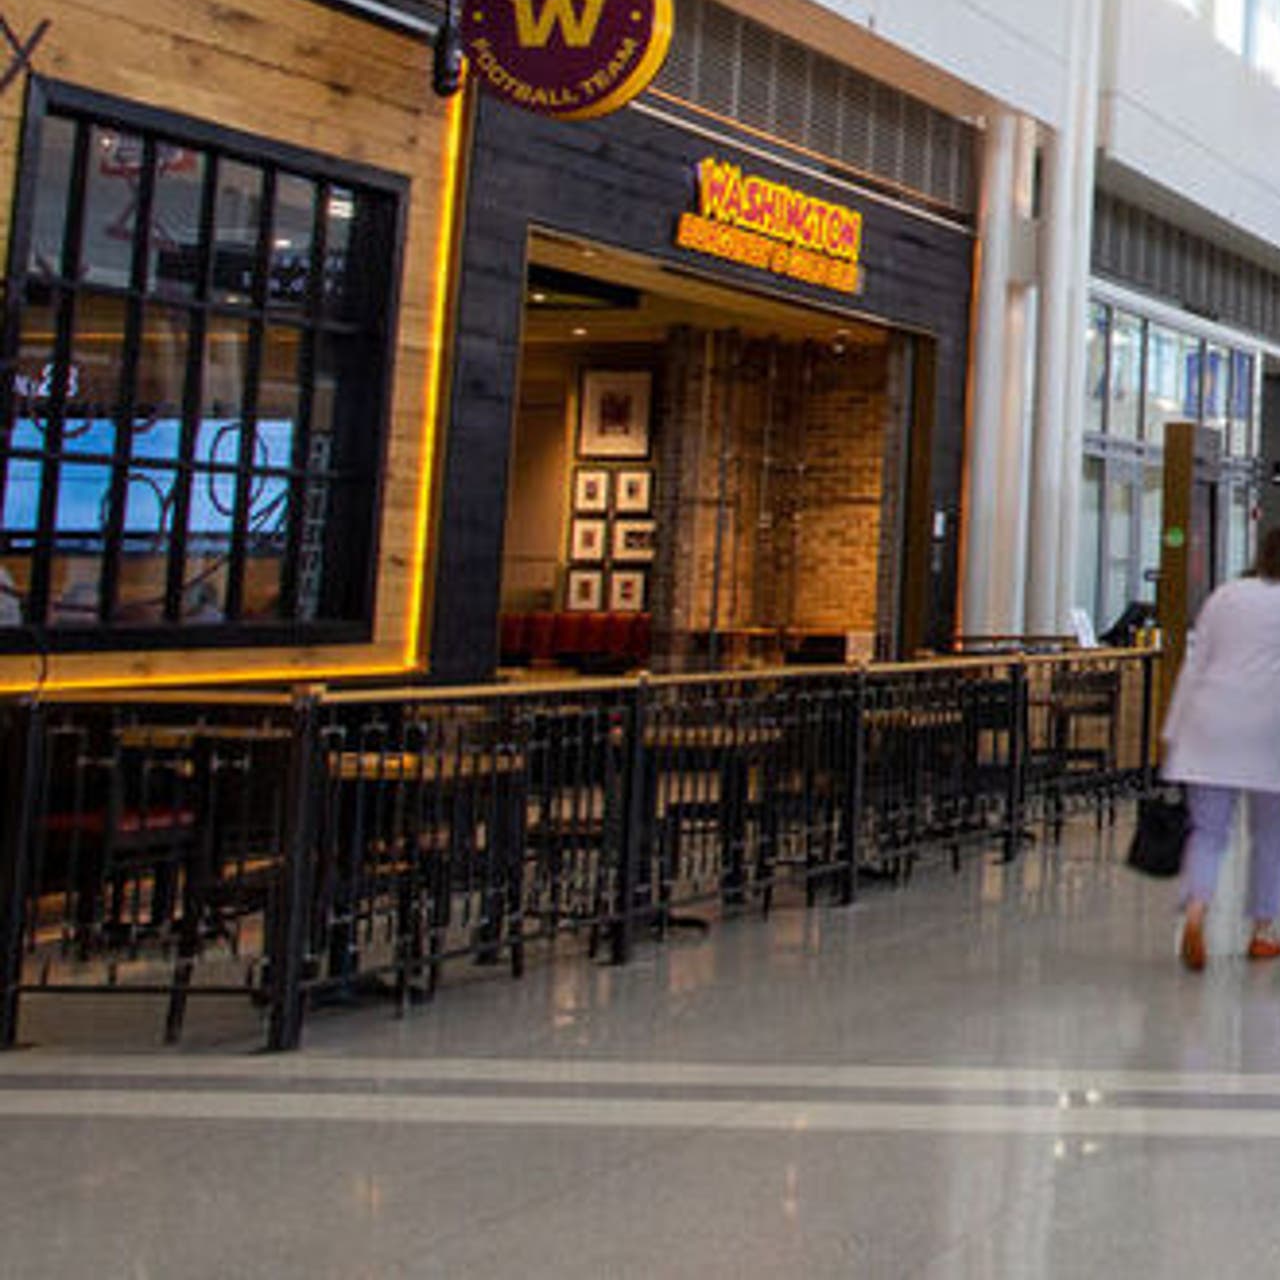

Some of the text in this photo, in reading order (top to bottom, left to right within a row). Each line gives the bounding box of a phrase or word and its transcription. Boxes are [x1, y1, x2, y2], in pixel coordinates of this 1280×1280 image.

[471, 37, 638, 106] FOOTBALL TEAM
[700, 158, 863, 262] WASHINGTON
